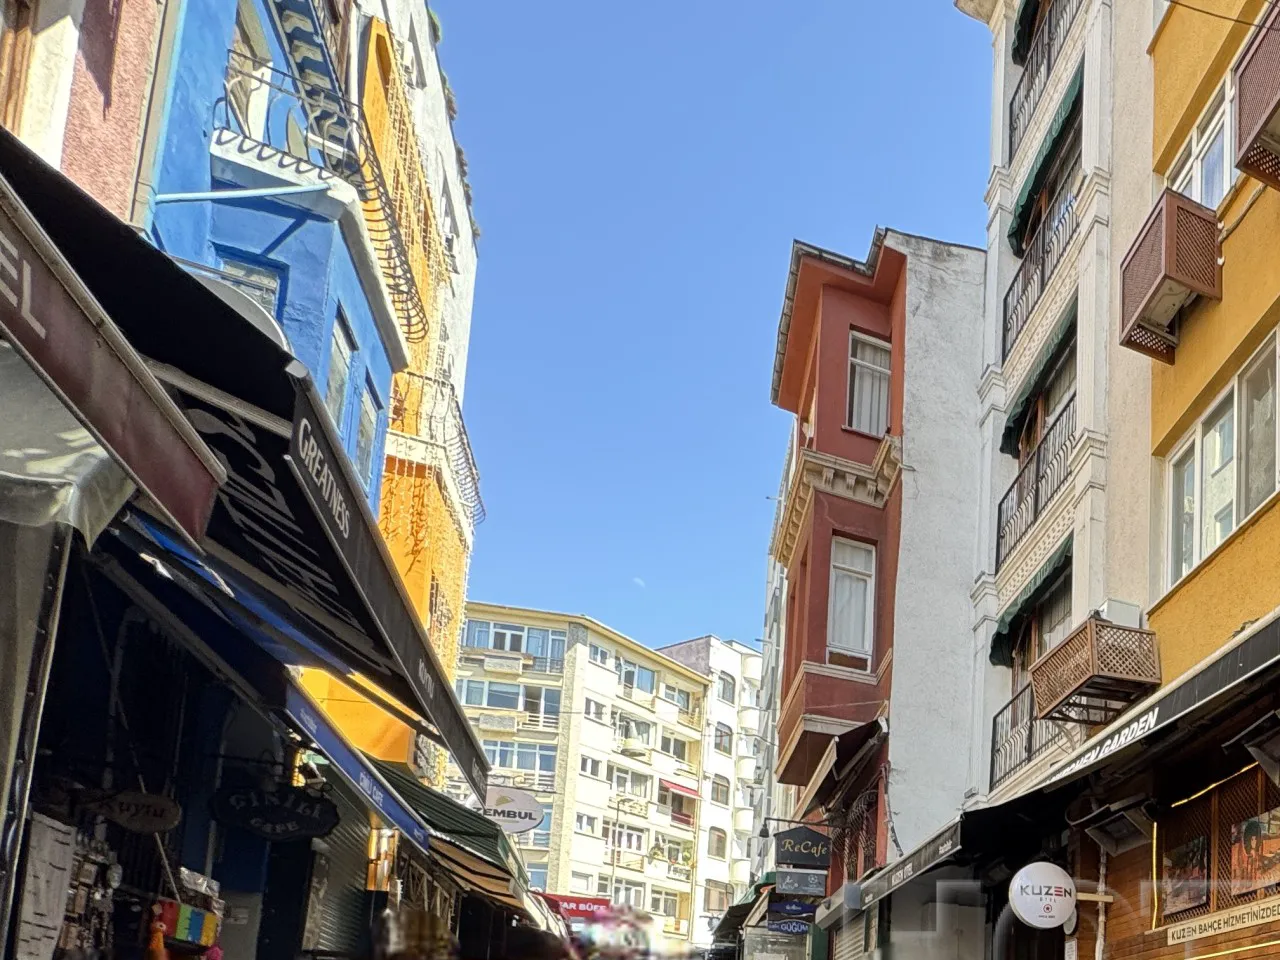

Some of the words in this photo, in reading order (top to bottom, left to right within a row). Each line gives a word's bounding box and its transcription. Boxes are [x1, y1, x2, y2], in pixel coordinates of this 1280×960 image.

[298, 418, 350, 539] GREATNESS
[1098, 706, 1160, 757] GARDEN
[780, 838, 828, 858] ReCafe
[1020, 885, 1072, 898] KUZEN
[1171, 926, 1197, 941] KUZEN
[1198, 919, 1222, 935] BAHÇE
